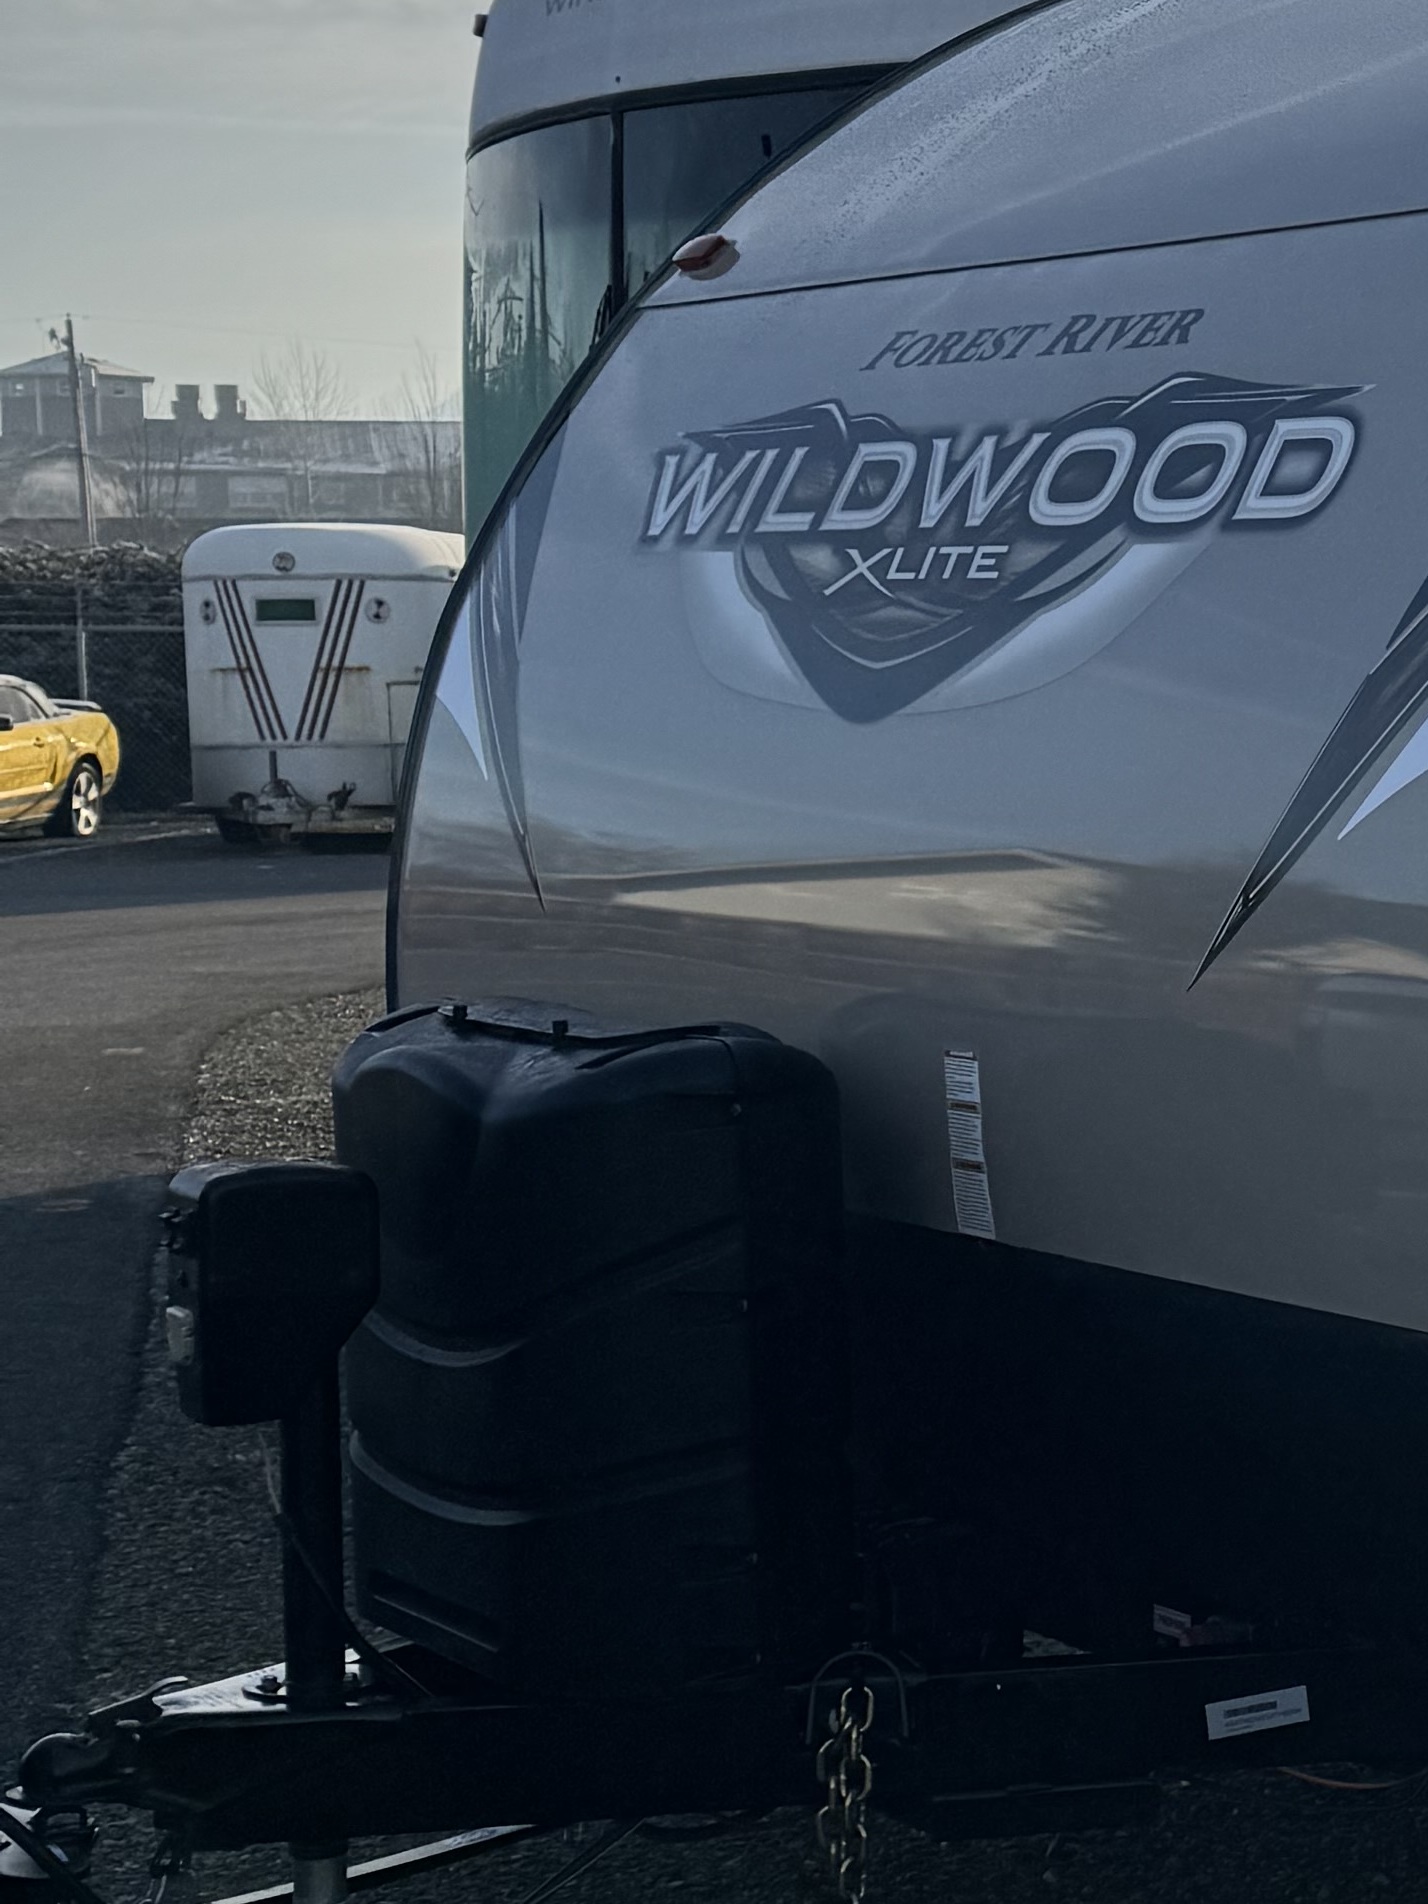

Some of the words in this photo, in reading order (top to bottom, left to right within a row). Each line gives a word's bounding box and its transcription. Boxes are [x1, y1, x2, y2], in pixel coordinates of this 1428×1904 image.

[859, 322, 1052, 372] FOREST
[1035, 308, 1204, 357] RIVER
[645, 415, 1357, 538] WILDWOOD
[823, 544, 1009, 597] XLITE
